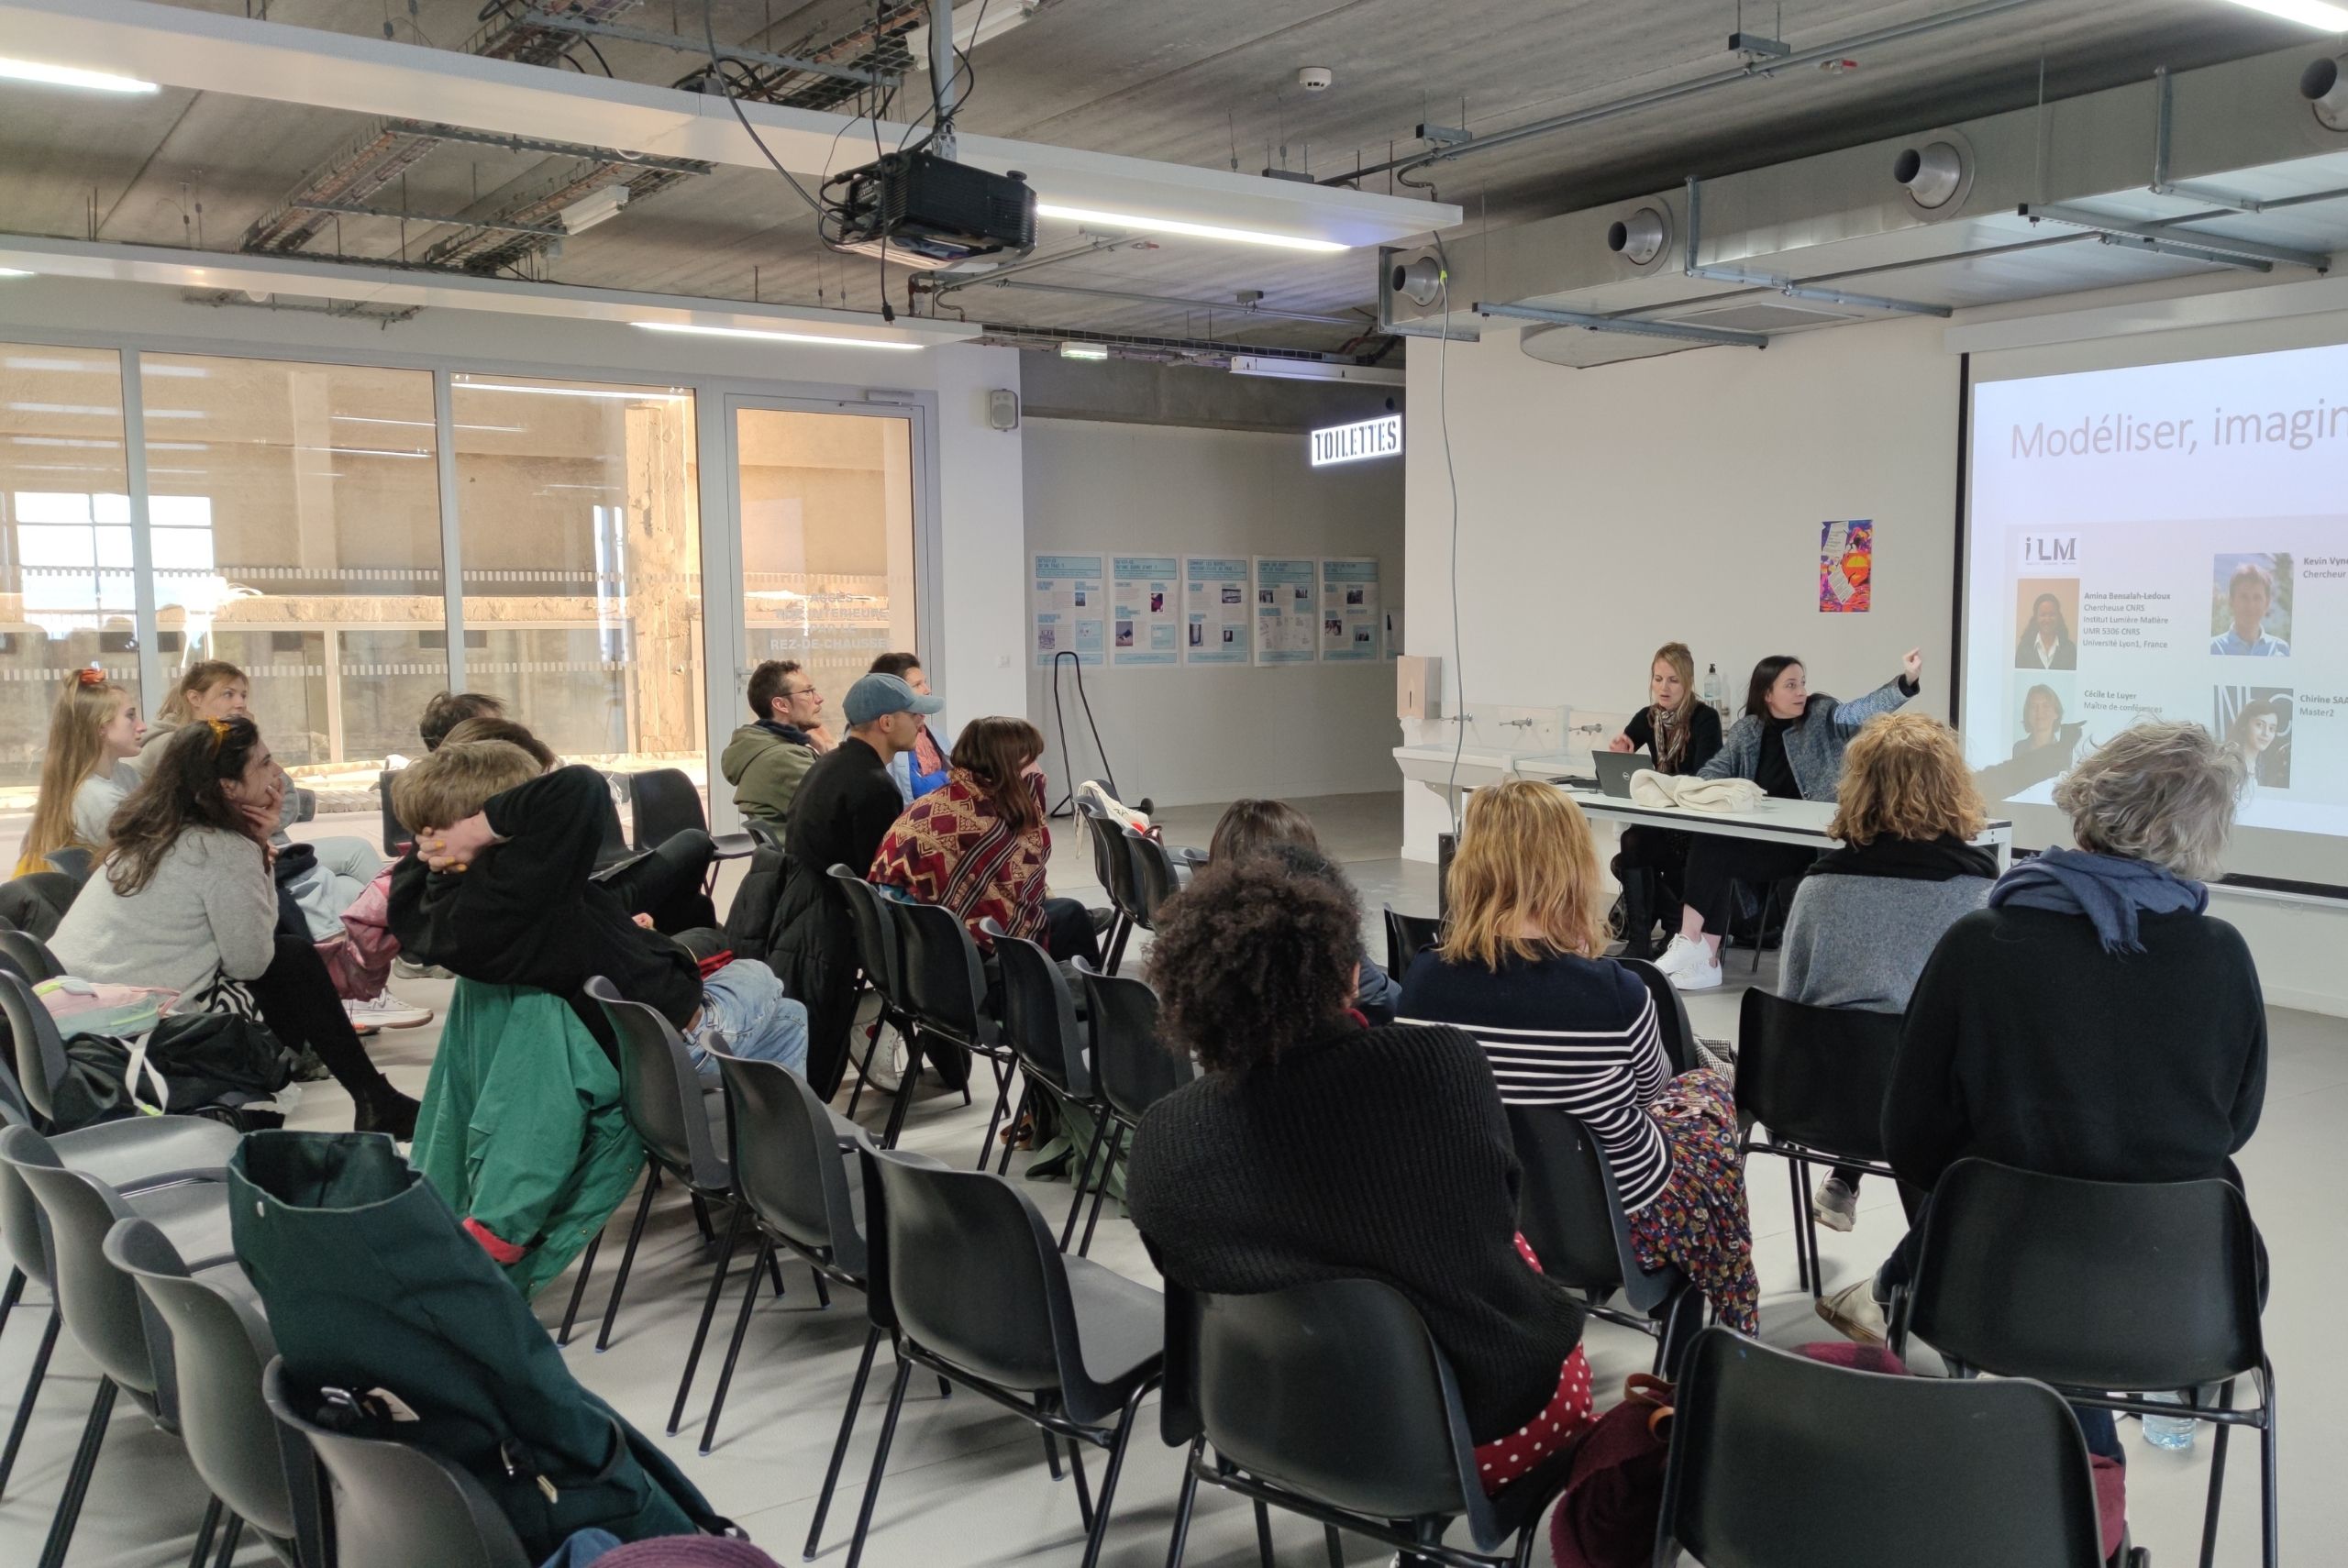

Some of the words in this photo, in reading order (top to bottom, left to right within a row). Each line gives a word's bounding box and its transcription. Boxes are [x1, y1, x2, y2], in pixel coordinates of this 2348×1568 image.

[1315, 420, 1397, 461] TOILETTES
[2011, 414, 2198, 459] Modéliser,
[2303, 557, 2328, 566] Kevin
[2303, 569, 2347, 579] Chercheur
[2084, 591, 2107, 600] Amina
[2109, 591, 2171, 600] Bensalah-Ledoux
[2084, 603, 2124, 613] Chercheuse
[2126, 604, 2145, 613] CNRS
[2083, 615, 2108, 624] Institut
[2110, 615, 2138, 624] Lumière
[2140, 616, 2169, 624] Matière
[2083, 627, 2100, 635] UMR
[2083, 638, 2118, 647] Université
[2143, 640, 2168, 649] France
[2084, 690, 2106, 698] Cécile
[2107, 690, 2115, 699] Le
[2117, 691, 2137, 701] Luyer
[2299, 694, 2331, 704] Chirine
[2084, 701, 2107, 711] Maître
[2109, 702, 2118, 711] de
[2299, 707, 2334, 717] Master2
